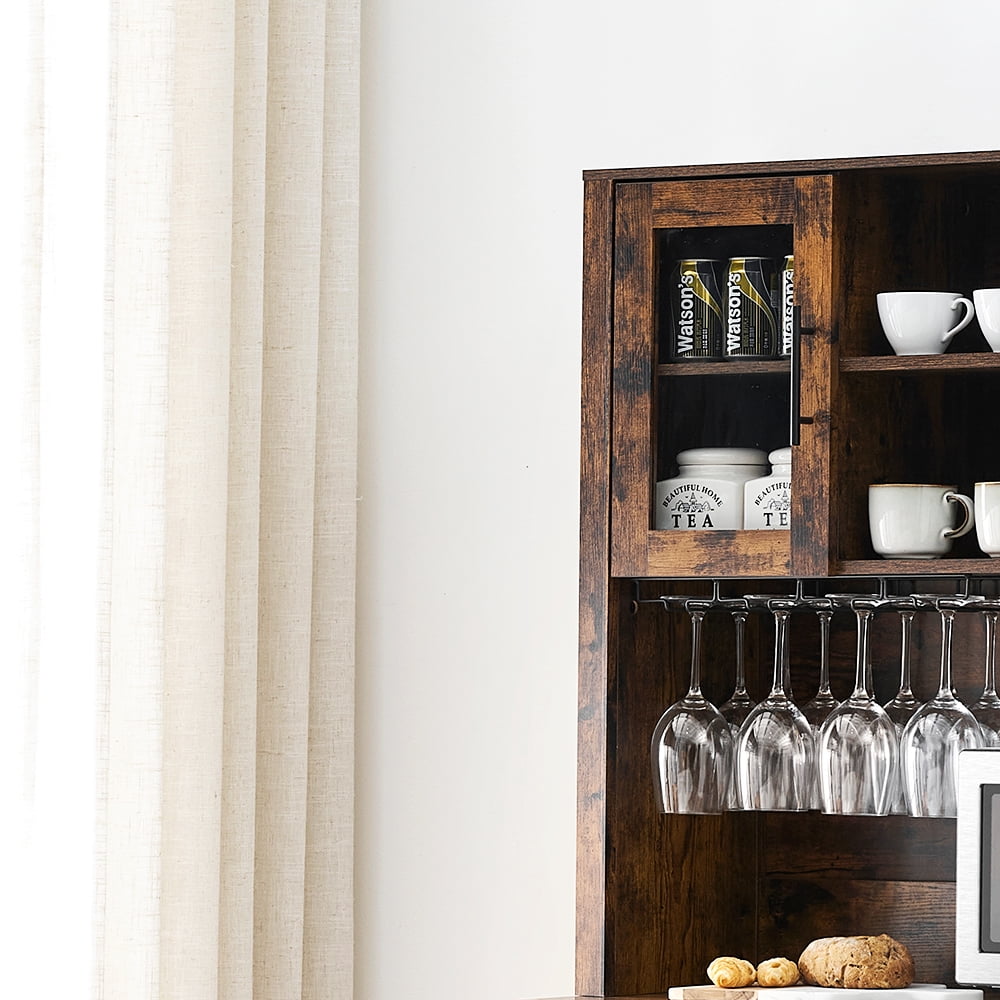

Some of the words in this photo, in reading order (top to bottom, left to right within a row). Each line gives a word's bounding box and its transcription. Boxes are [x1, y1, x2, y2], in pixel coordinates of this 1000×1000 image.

[677, 274, 694, 354] Watson's
[727, 272, 741, 352] Watson's
[662, 484, 700, 508] BEAUTIFUL
[701, 486, 723, 507] HOME
[671, 514, 714, 528] TEA
[763, 512, 788, 527] TE
